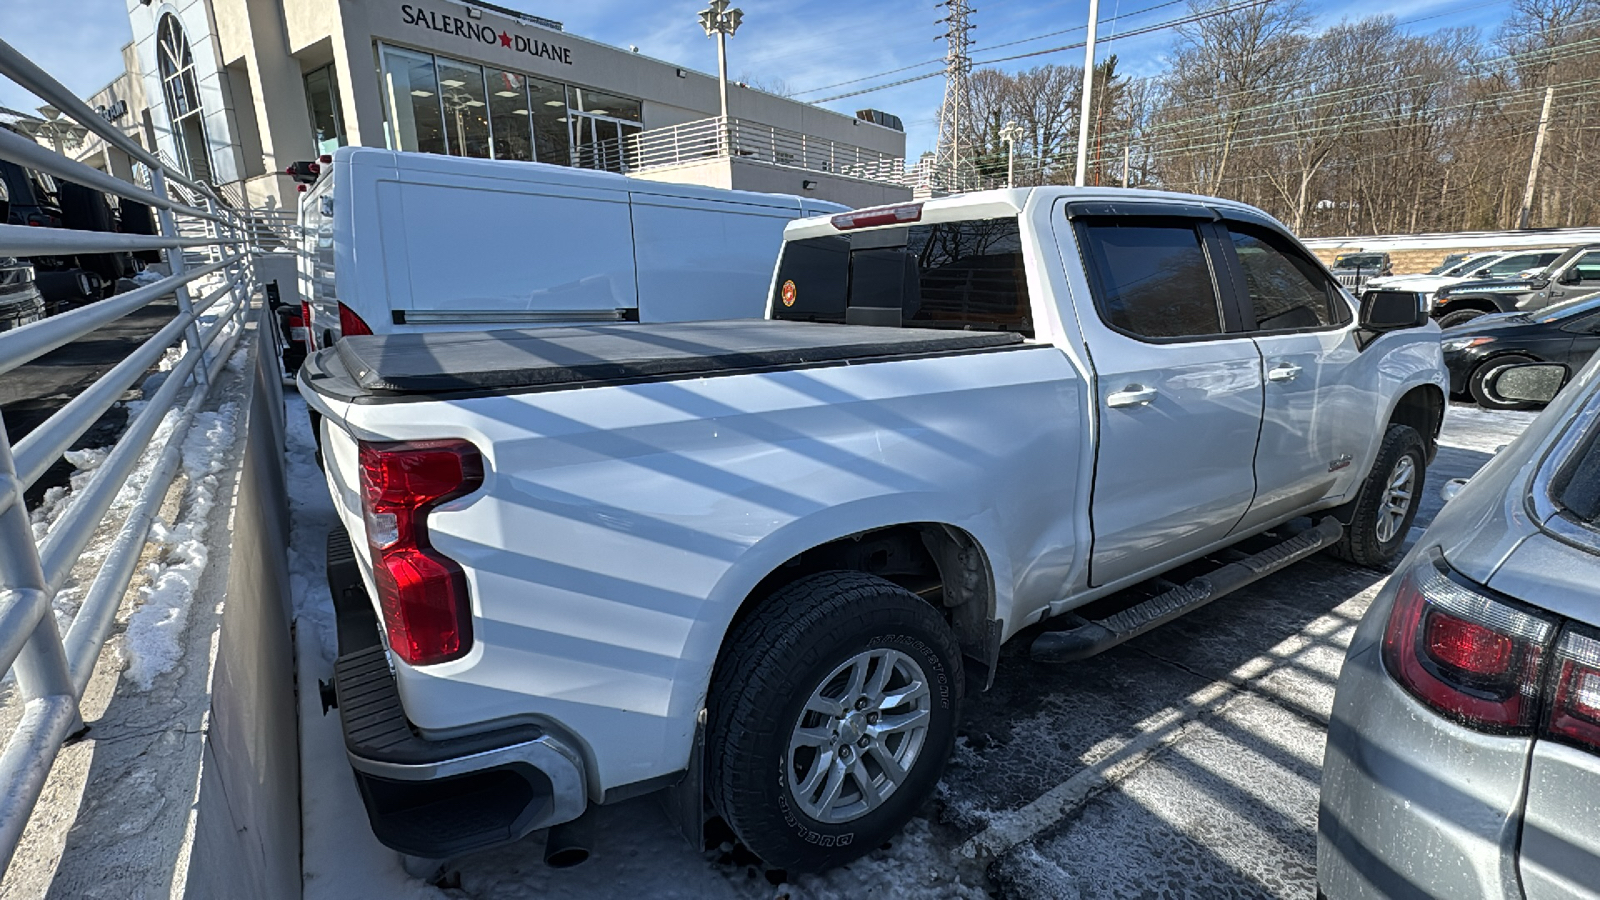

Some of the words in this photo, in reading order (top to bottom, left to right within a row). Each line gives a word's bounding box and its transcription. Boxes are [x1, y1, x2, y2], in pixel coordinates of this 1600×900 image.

[401, 4, 497, 44] SALERNO
[514, 34, 572, 65] DUANE
[866, 634, 949, 709] BRIDGESTONE
